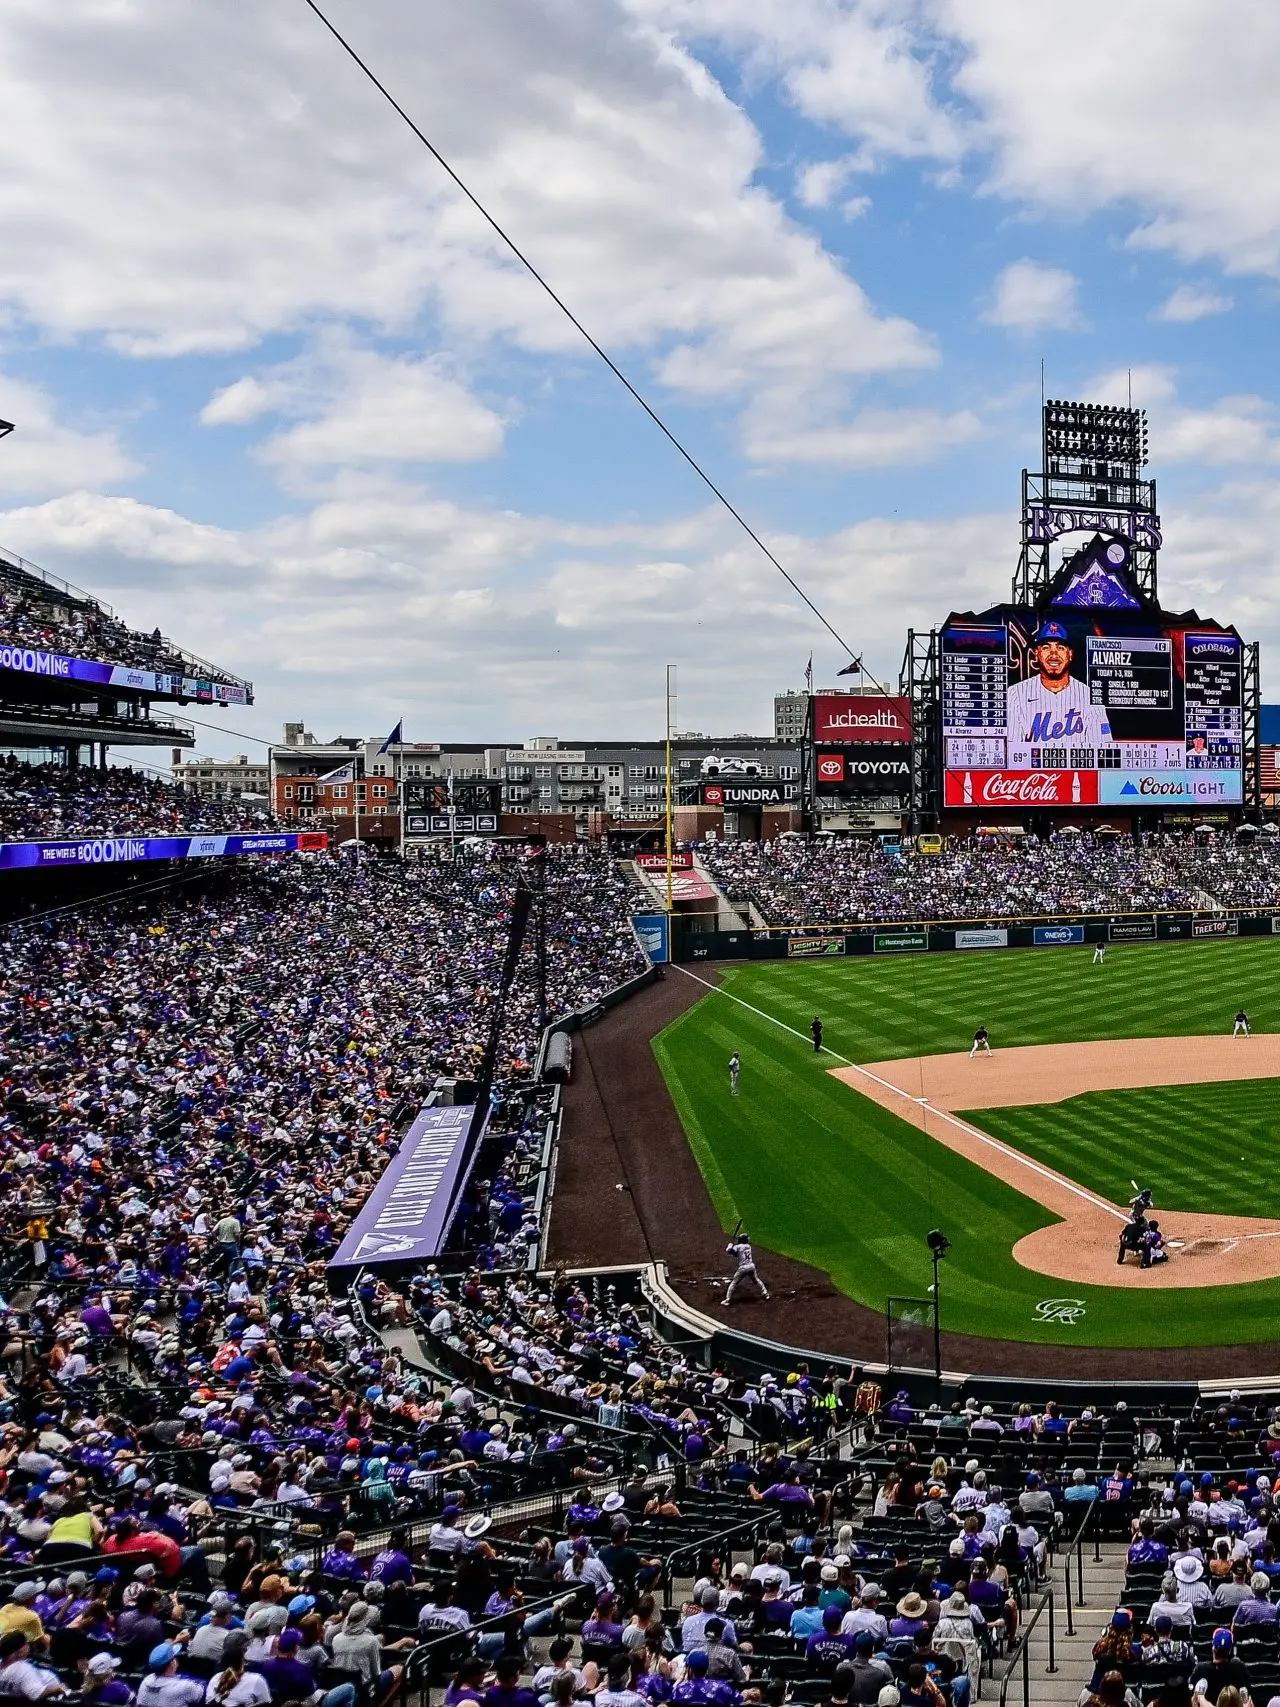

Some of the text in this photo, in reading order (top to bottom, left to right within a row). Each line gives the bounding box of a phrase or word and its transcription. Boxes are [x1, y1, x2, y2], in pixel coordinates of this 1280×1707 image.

[1031, 507, 1163, 549] ROCKIES
[1092, 641, 1121, 649] FRANCISCO
[1192, 643, 1234, 655] COLORADO
[1092, 652, 1132, 665] ALVAREZ
[829, 709, 897, 727] uchealth
[1025, 708, 1084, 742] Mets
[1232, 745, 1239, 753] 10
[1013, 752, 1027, 762] 69°
[848, 762, 910, 774] TOYOTA
[983, 773, 1061, 801] Coca-Cola
[1139, 776, 1225, 796] Coors LIGHT
[723, 789, 779, 800] TUNDRA
[43, 850, 55, 859] THE
[78, 840, 145, 863] BOOOMING
[641, 855, 685, 866] uchelth
[390, 1172, 443, 1198] COORS
[374, 1199, 432, 1229] FIELD
